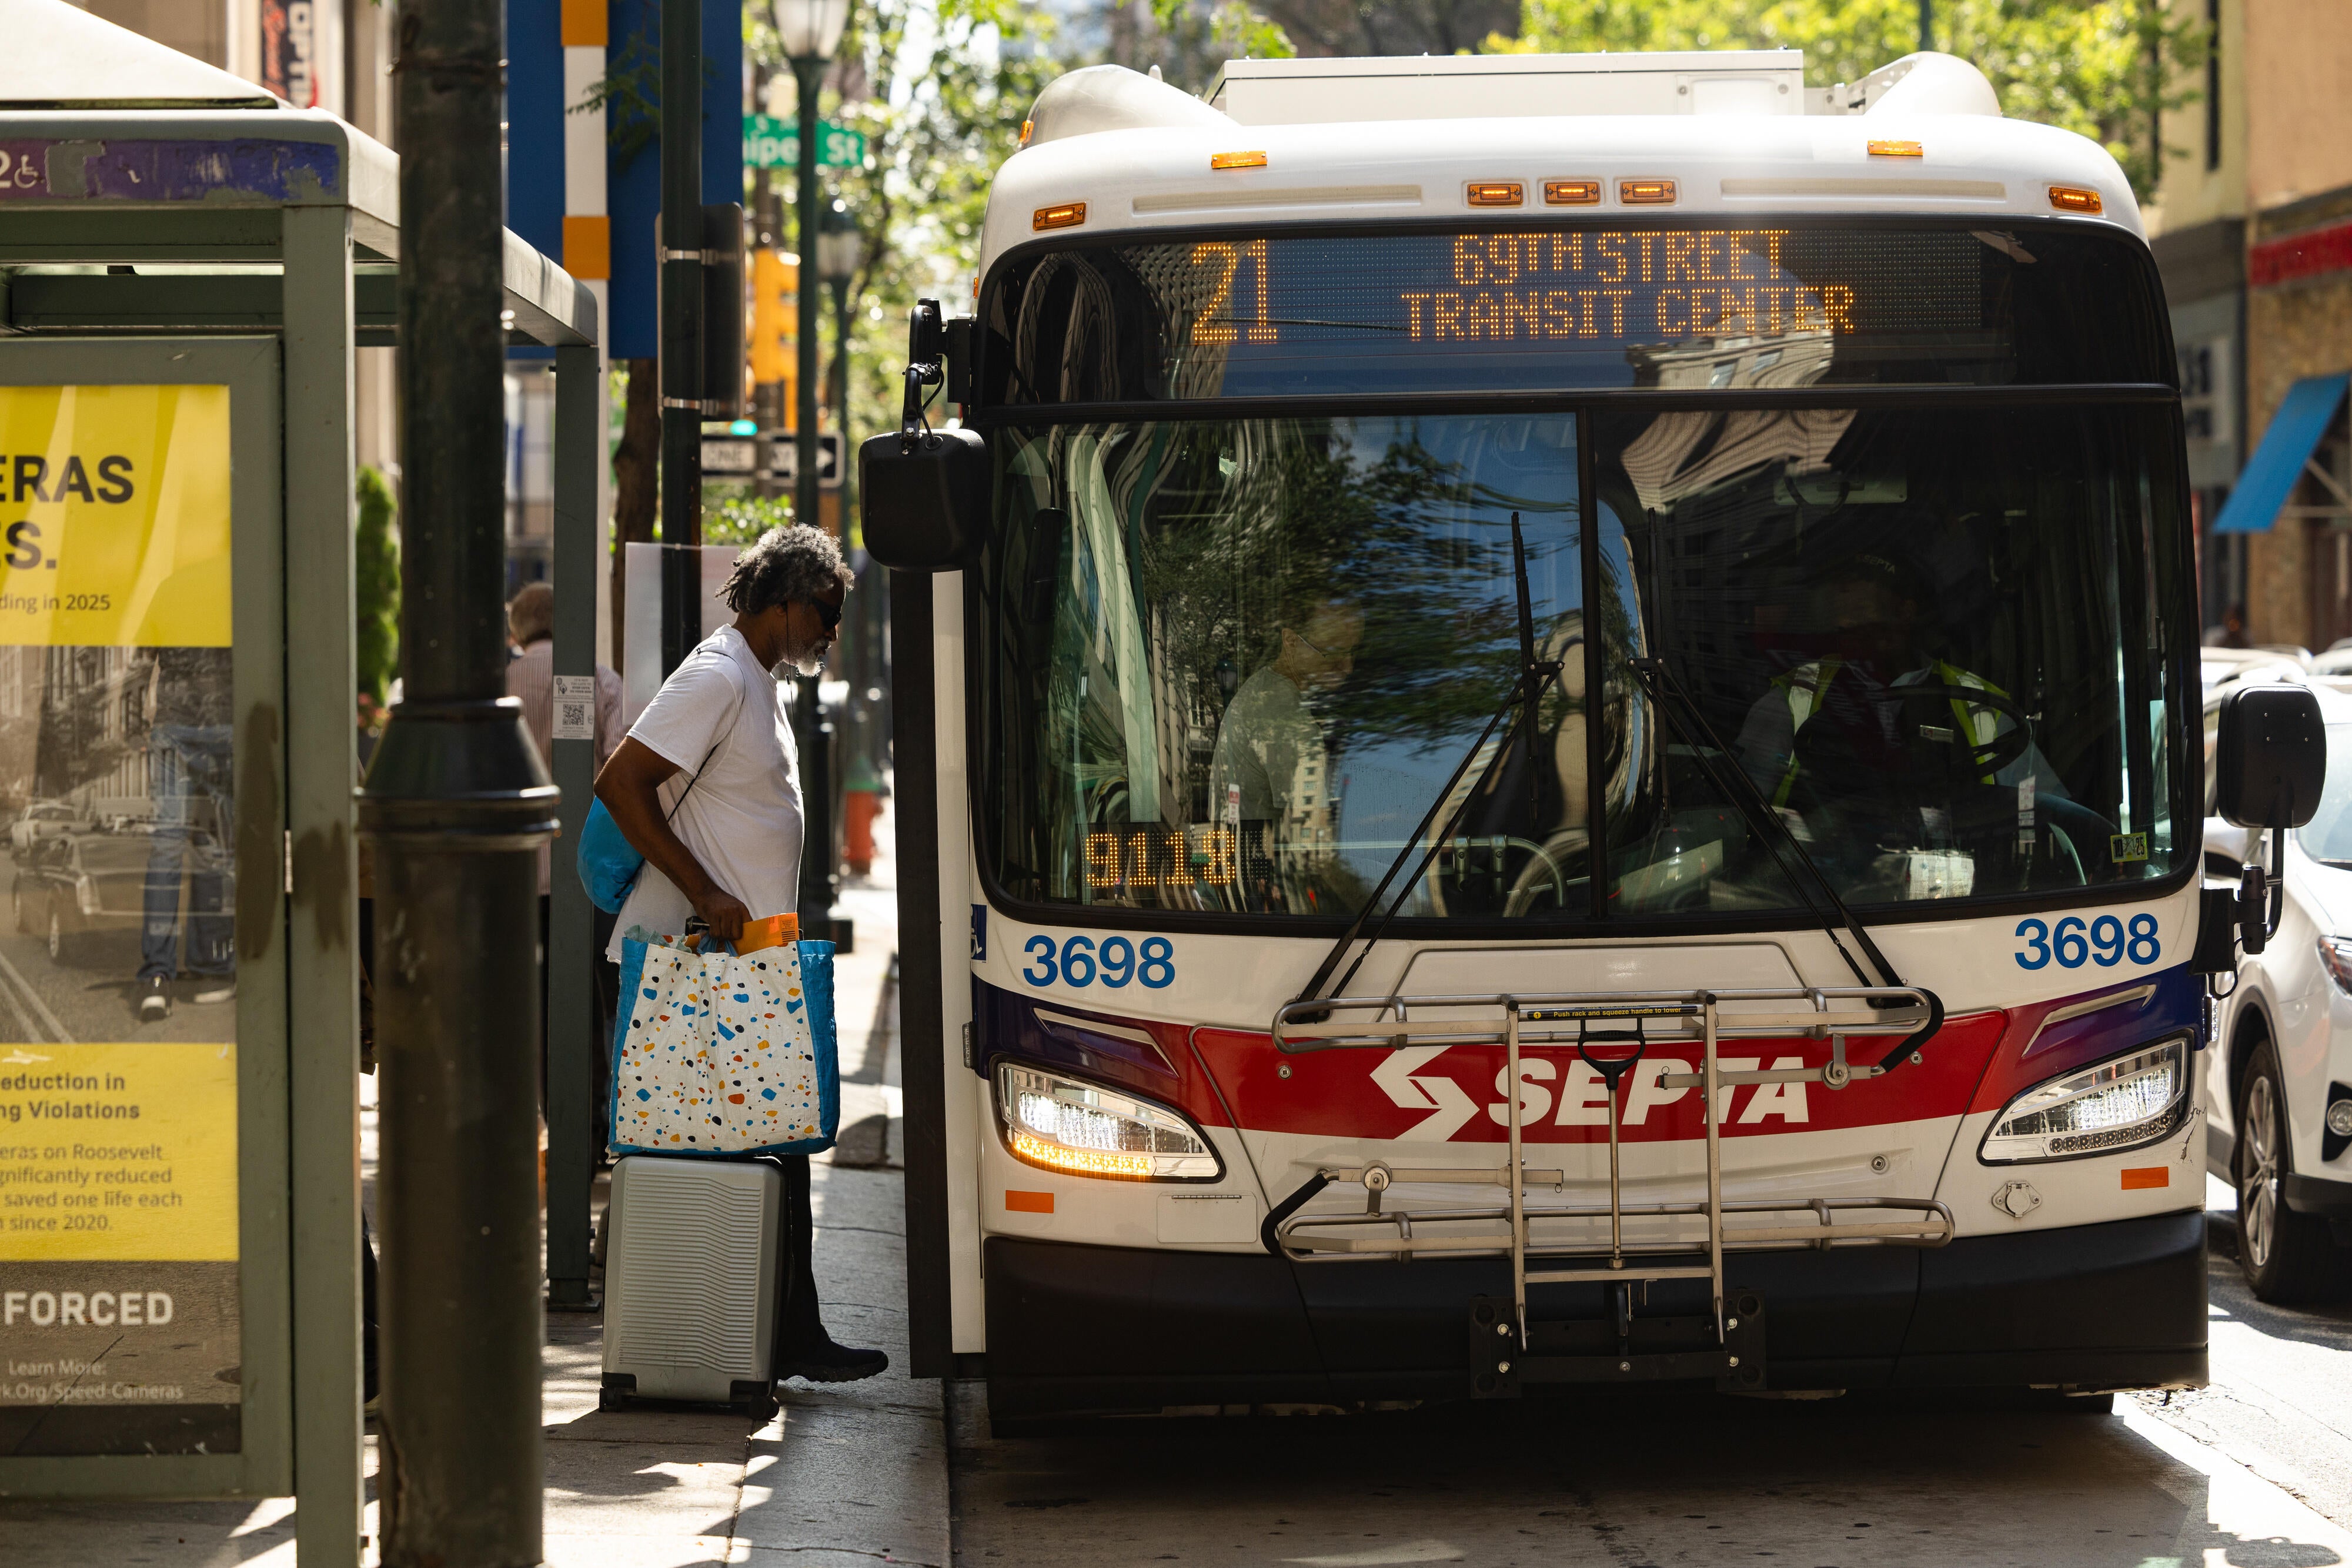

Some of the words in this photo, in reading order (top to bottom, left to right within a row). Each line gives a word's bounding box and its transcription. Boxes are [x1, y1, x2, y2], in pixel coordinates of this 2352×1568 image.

[826, 132, 859, 164] St
[1455, 234, 1582, 285] 69TH
[1598, 229, 1789, 283] STREET
[1192, 239, 1275, 341] 21
[1401, 290, 1632, 337] TRANSIT
[1657, 286, 1854, 333] CENTER
[44, 593, 60, 610] in
[66, 594, 111, 611] 2025
[1086, 830, 1235, 887] 9118
[2135, 836, 2145, 856] 25
[2014, 913, 2161, 970] 3698
[1023, 934, 1175, 989] 3698
[1, 1072, 99, 1091] eduction
[105, 1072, 126, 1091] in
[1488, 1057, 1809, 1127] SEPTA
[29, 1101, 141, 1119] Violations
[44, 1146, 67, 1160] on
[72, 1143, 163, 1161] Roosevelt
[95, 1167, 173, 1184] reduced
[5, 1191, 57, 1208] saved
[63, 1195, 99, 1208] one
[104, 1191, 133, 1207] life
[138, 1191, 183, 1207] each
[9, 1213, 57, 1231] since
[62, 1214, 112, 1231] 2020.
[4, 1291, 174, 1326] FORCED
[9, 1359, 55, 1376] Learn
